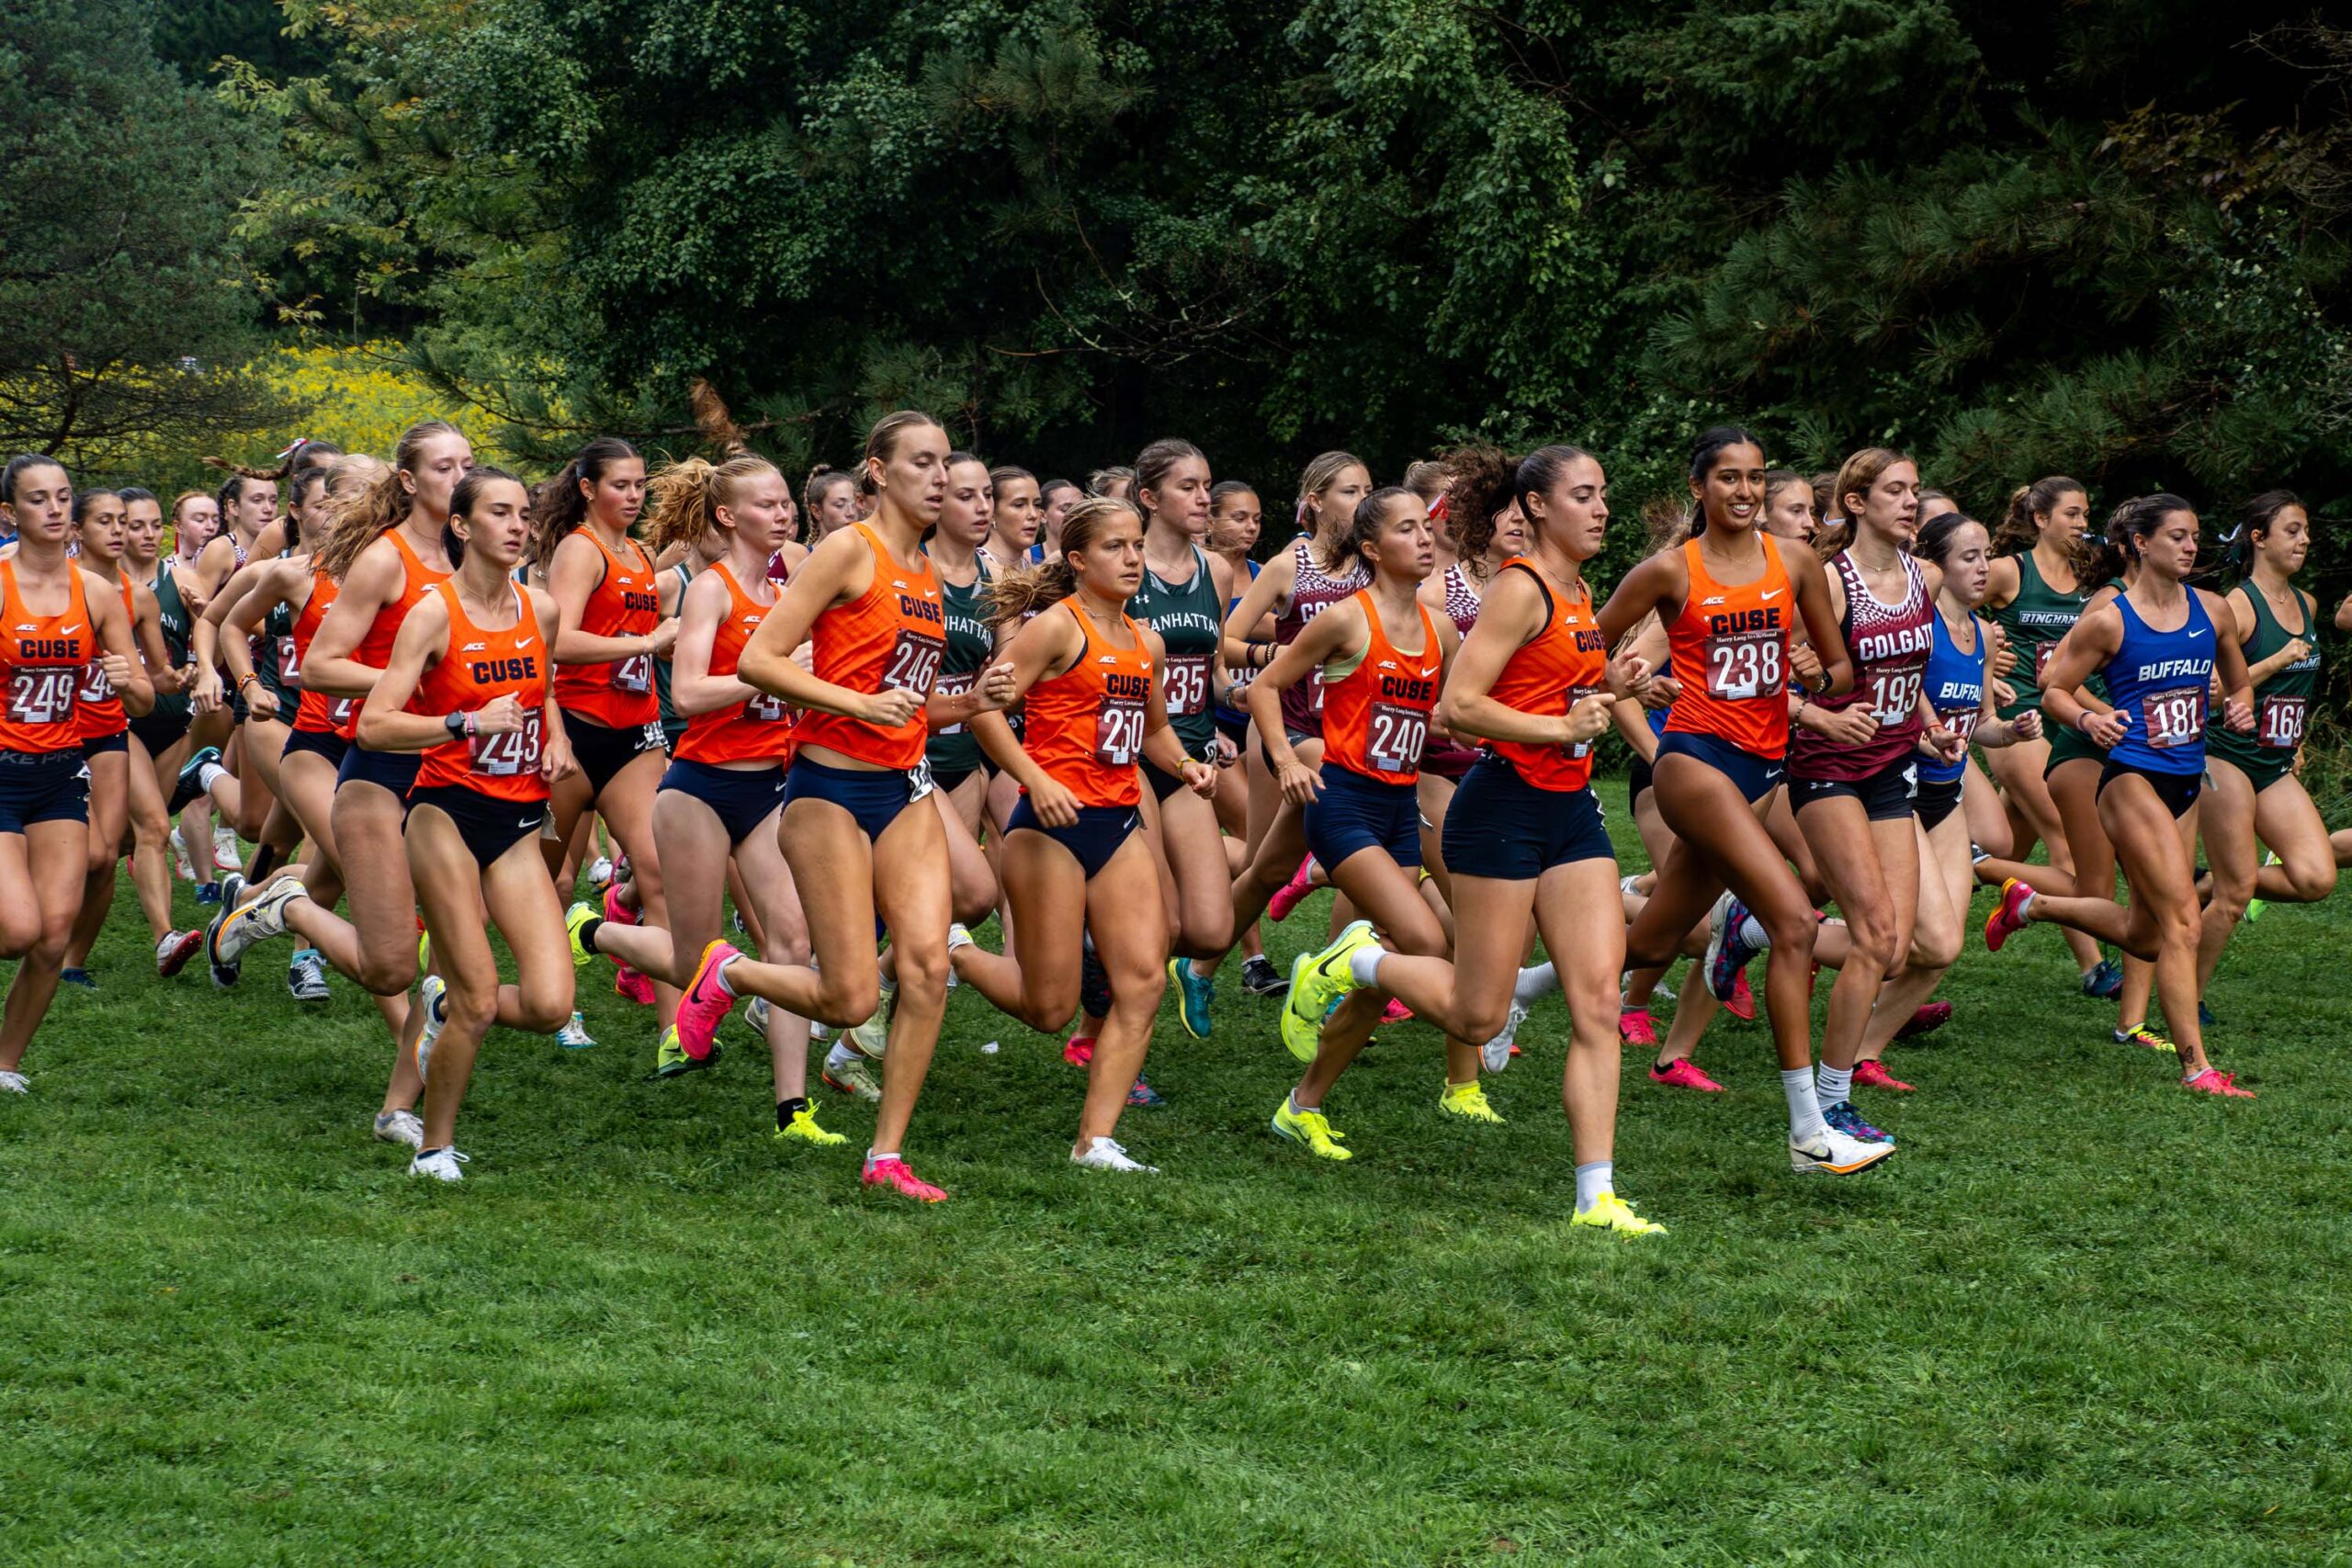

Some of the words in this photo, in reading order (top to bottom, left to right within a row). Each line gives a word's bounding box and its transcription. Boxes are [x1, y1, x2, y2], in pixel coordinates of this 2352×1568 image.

[1702, 596, 1725, 606] ACC
[2020, 613, 2080, 625] BINGHAM
[1150, 612, 1220, 638] ANHATTAN
[1859, 623, 1933, 661] COLGAT
[462, 642, 486, 652] ACC
[885, 641, 941, 693] 246
[1713, 640, 1780, 691] 238
[2137, 659, 2211, 682] BUFFALO
[12, 674, 74, 713] 249
[1870, 672, 1922, 717] 193
[1939, 682, 1983, 702] BUFFAL
[2153, 696, 2201, 738] 181
[2267, 705, 2304, 739] 168
[1371, 715, 1426, 763] 240
